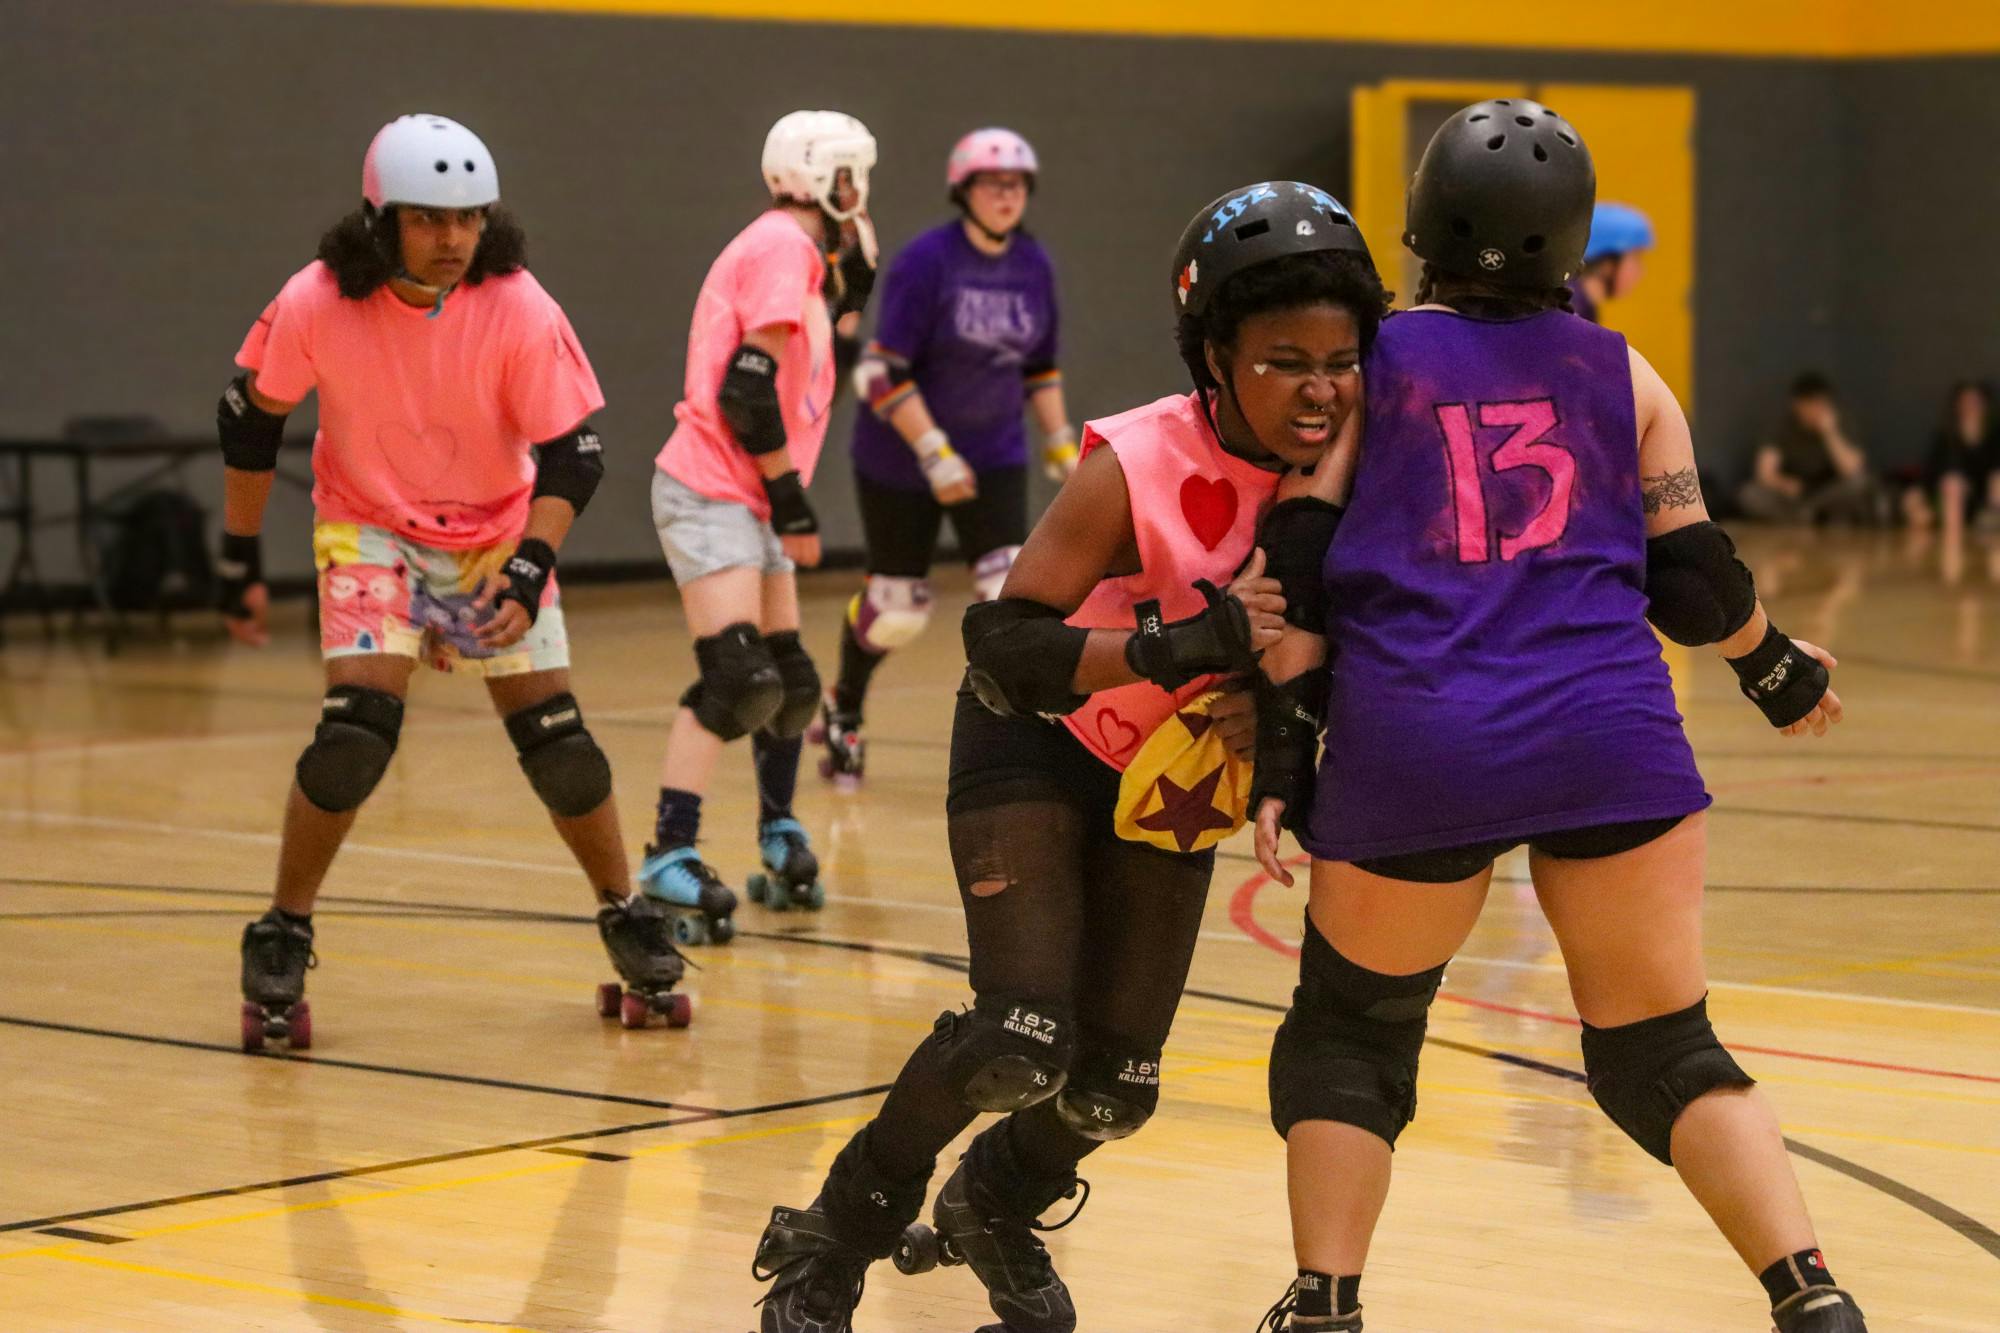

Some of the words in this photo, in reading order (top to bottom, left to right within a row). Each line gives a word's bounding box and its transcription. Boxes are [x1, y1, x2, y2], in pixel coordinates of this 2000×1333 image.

[1434, 396, 1576, 566] 13
[1009, 1008, 1056, 1033] 187
[1003, 1020, 1031, 1036] KILLER
[1031, 1029, 1054, 1044] PADS
[1033, 1072, 1047, 1086] XS
[1118, 1072, 1145, 1084] KILLER
[1091, 1105, 1113, 1122] XS
